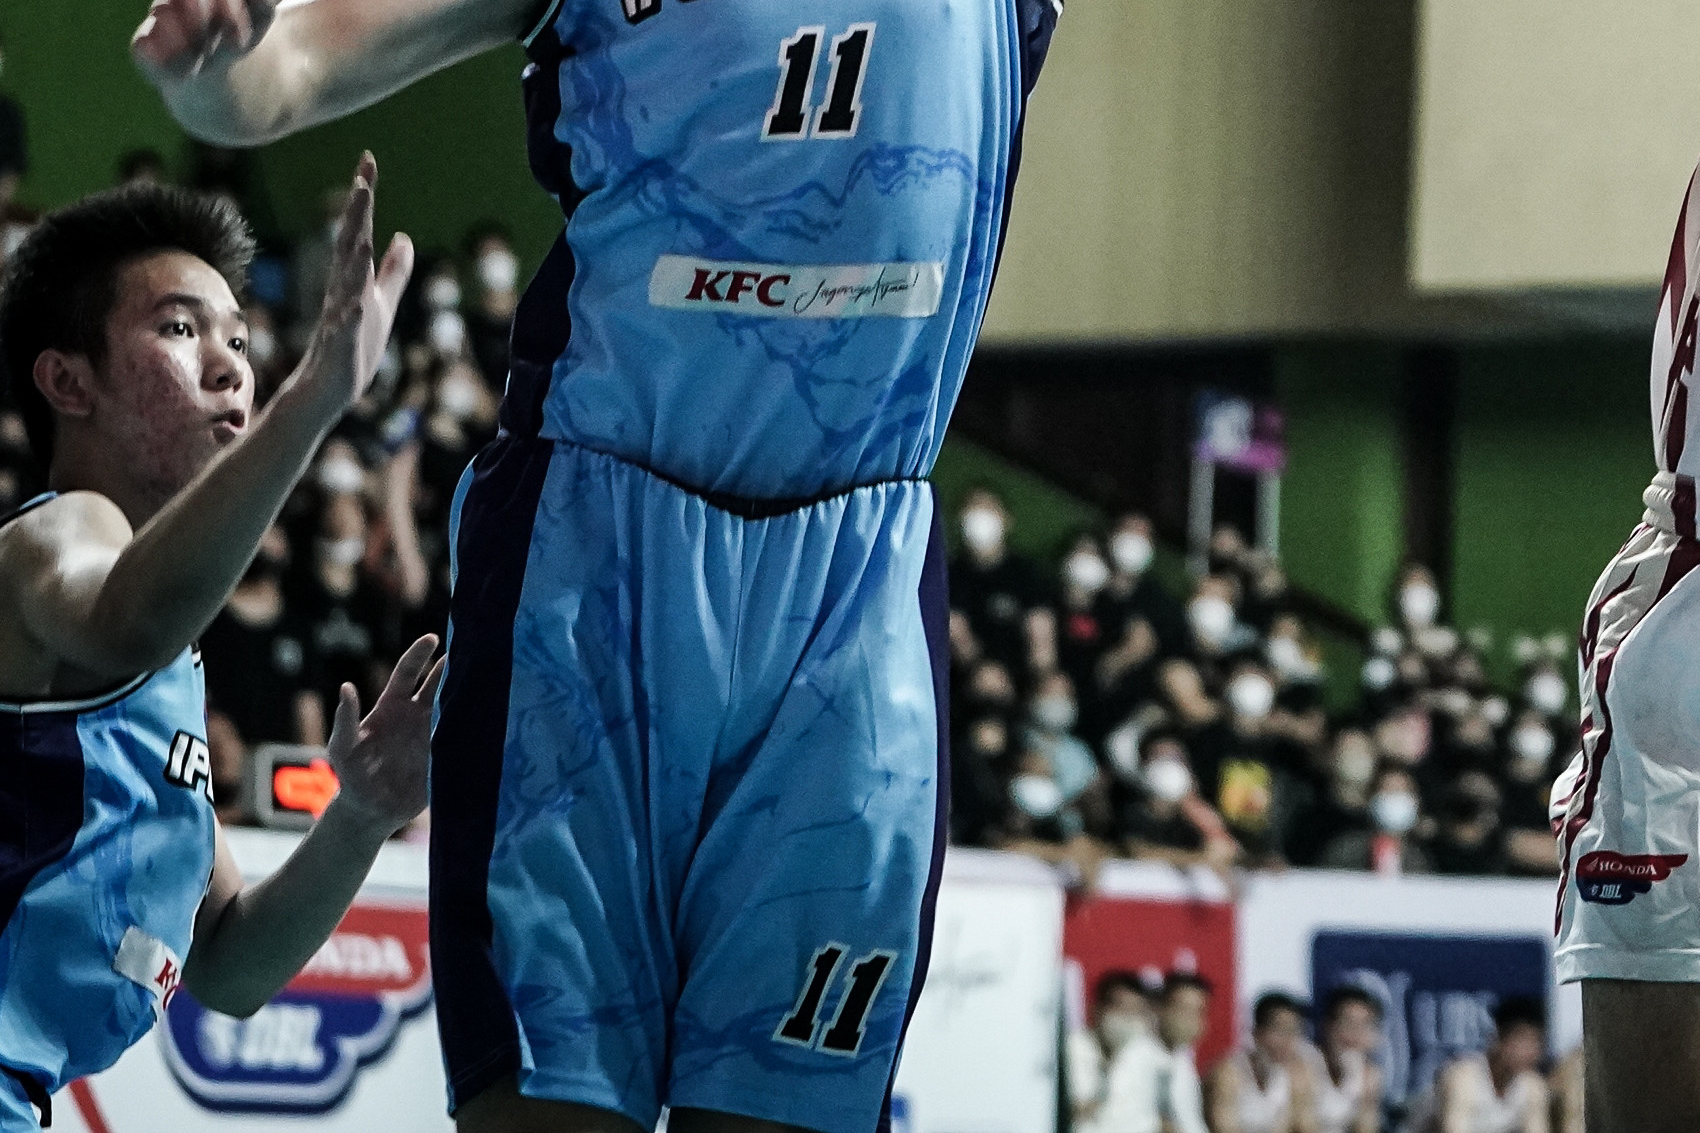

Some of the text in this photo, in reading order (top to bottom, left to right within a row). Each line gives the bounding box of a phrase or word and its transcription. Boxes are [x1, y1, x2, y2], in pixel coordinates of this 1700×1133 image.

[761, 21, 877, 143] 11
[685, 268, 791, 307] KFC
[1599, 860, 1657, 876] HONDA
[772, 941, 898, 1058] 11
